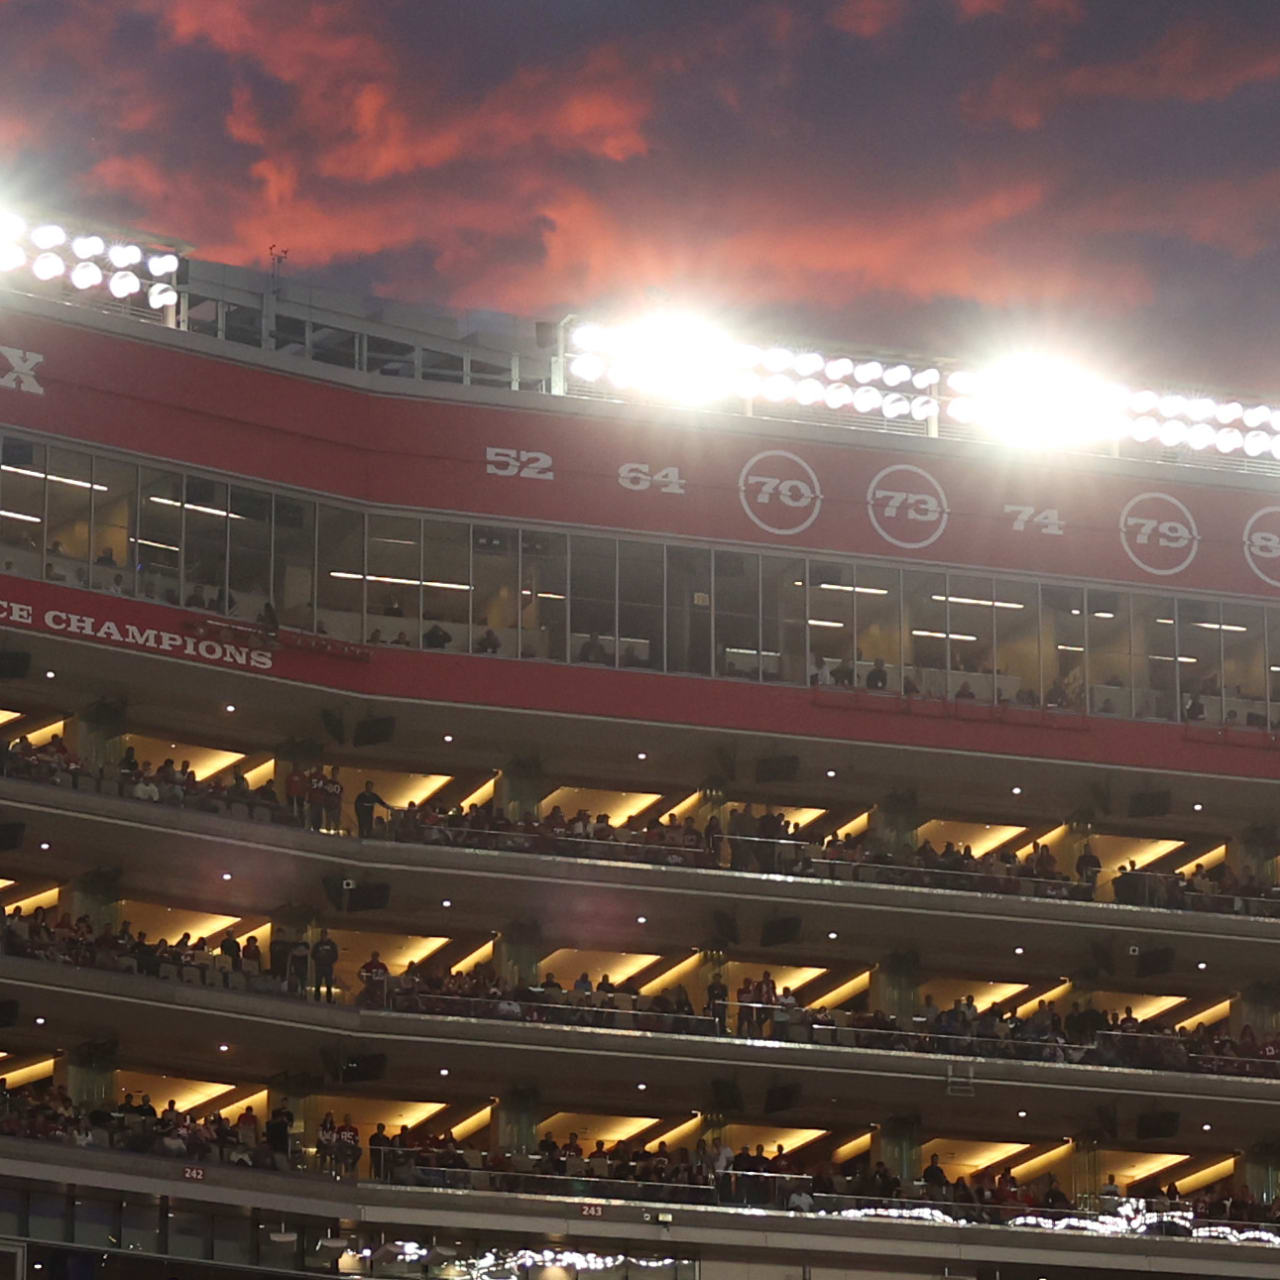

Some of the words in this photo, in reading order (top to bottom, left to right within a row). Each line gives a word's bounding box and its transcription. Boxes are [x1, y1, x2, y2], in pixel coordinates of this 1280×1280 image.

[486, 448, 554, 480] 52
[619, 462, 686, 494] 64
[747, 475, 812, 508] 70
[875, 490, 939, 521] 73
[1004, 504, 1064, 535] 74
[1125, 518, 1190, 549] 79
[44, 611, 273, 670] CHAMPIONS
[184, 1168, 204, 1180] 242
[582, 1206, 603, 1216] 243
